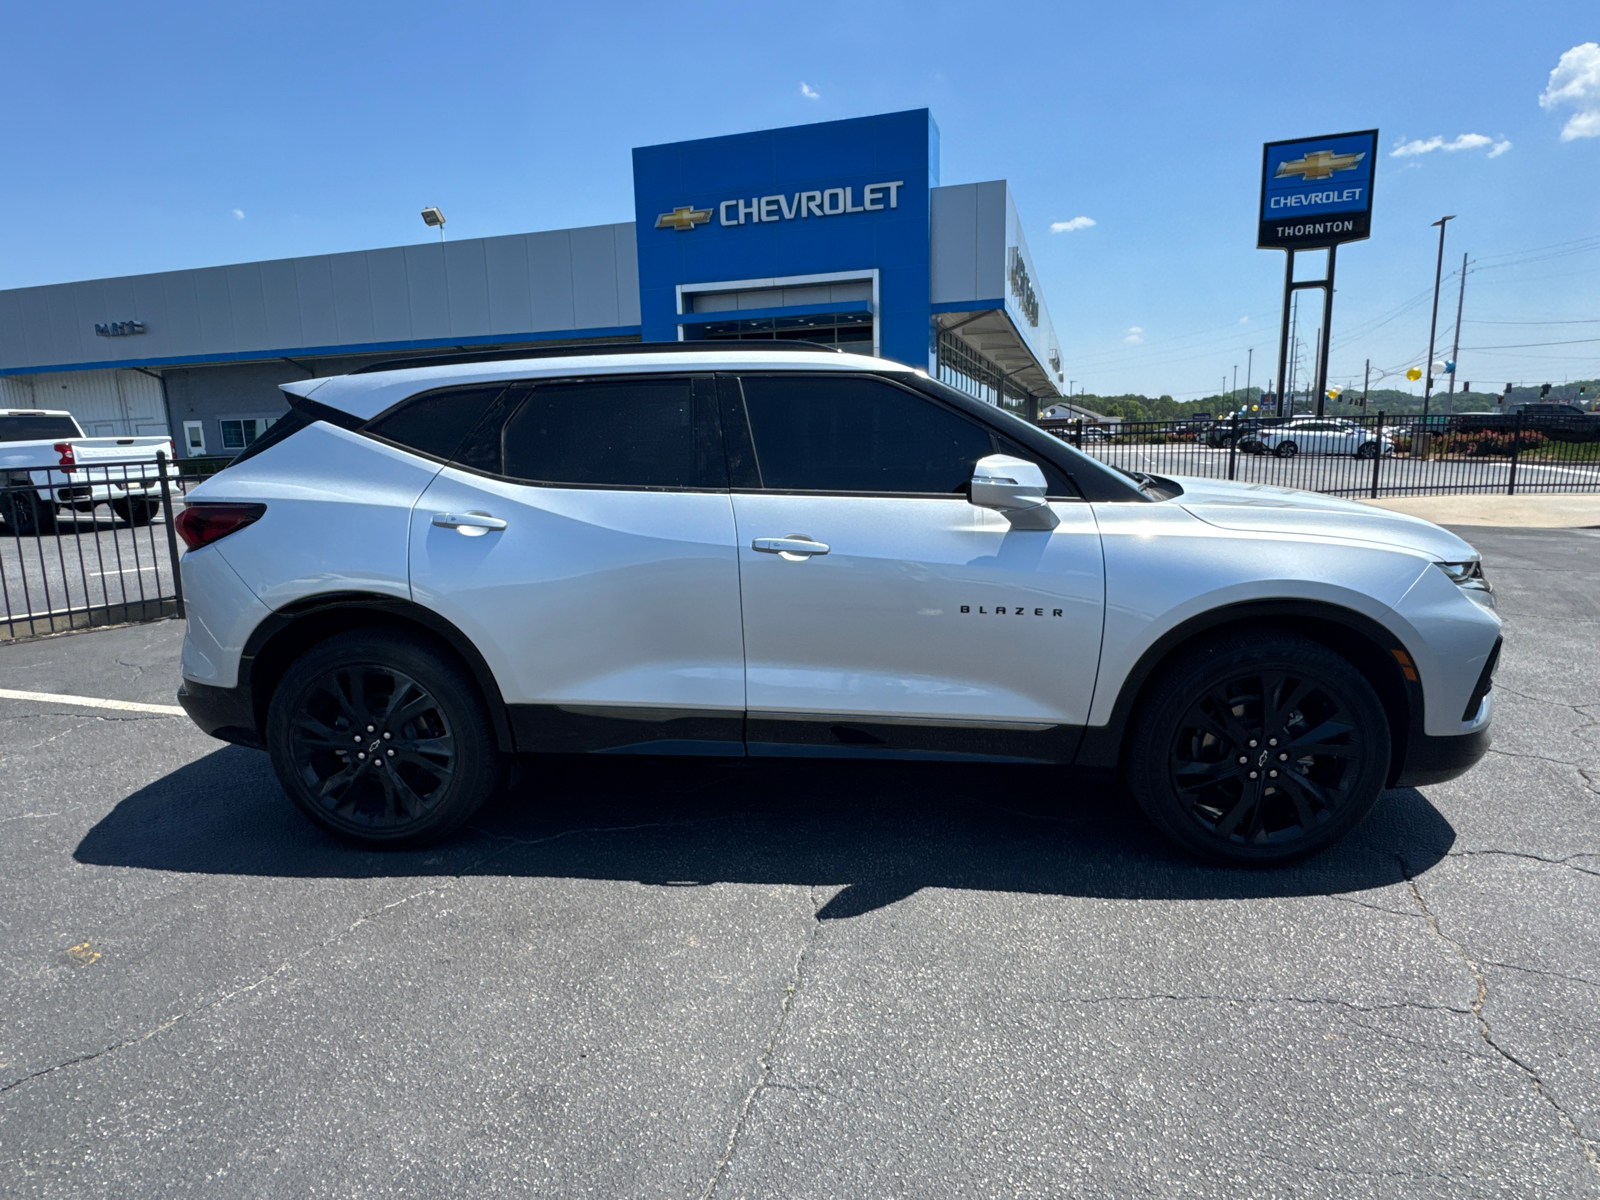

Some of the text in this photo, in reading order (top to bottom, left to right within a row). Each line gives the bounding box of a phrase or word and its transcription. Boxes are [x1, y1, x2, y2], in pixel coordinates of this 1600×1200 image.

[719, 180, 904, 226] CHEVROLET
[1270, 188, 1363, 209] CHEVROLET
[1276, 220, 1354, 238] THORNTON
[960, 604, 1063, 617] BLAZER
